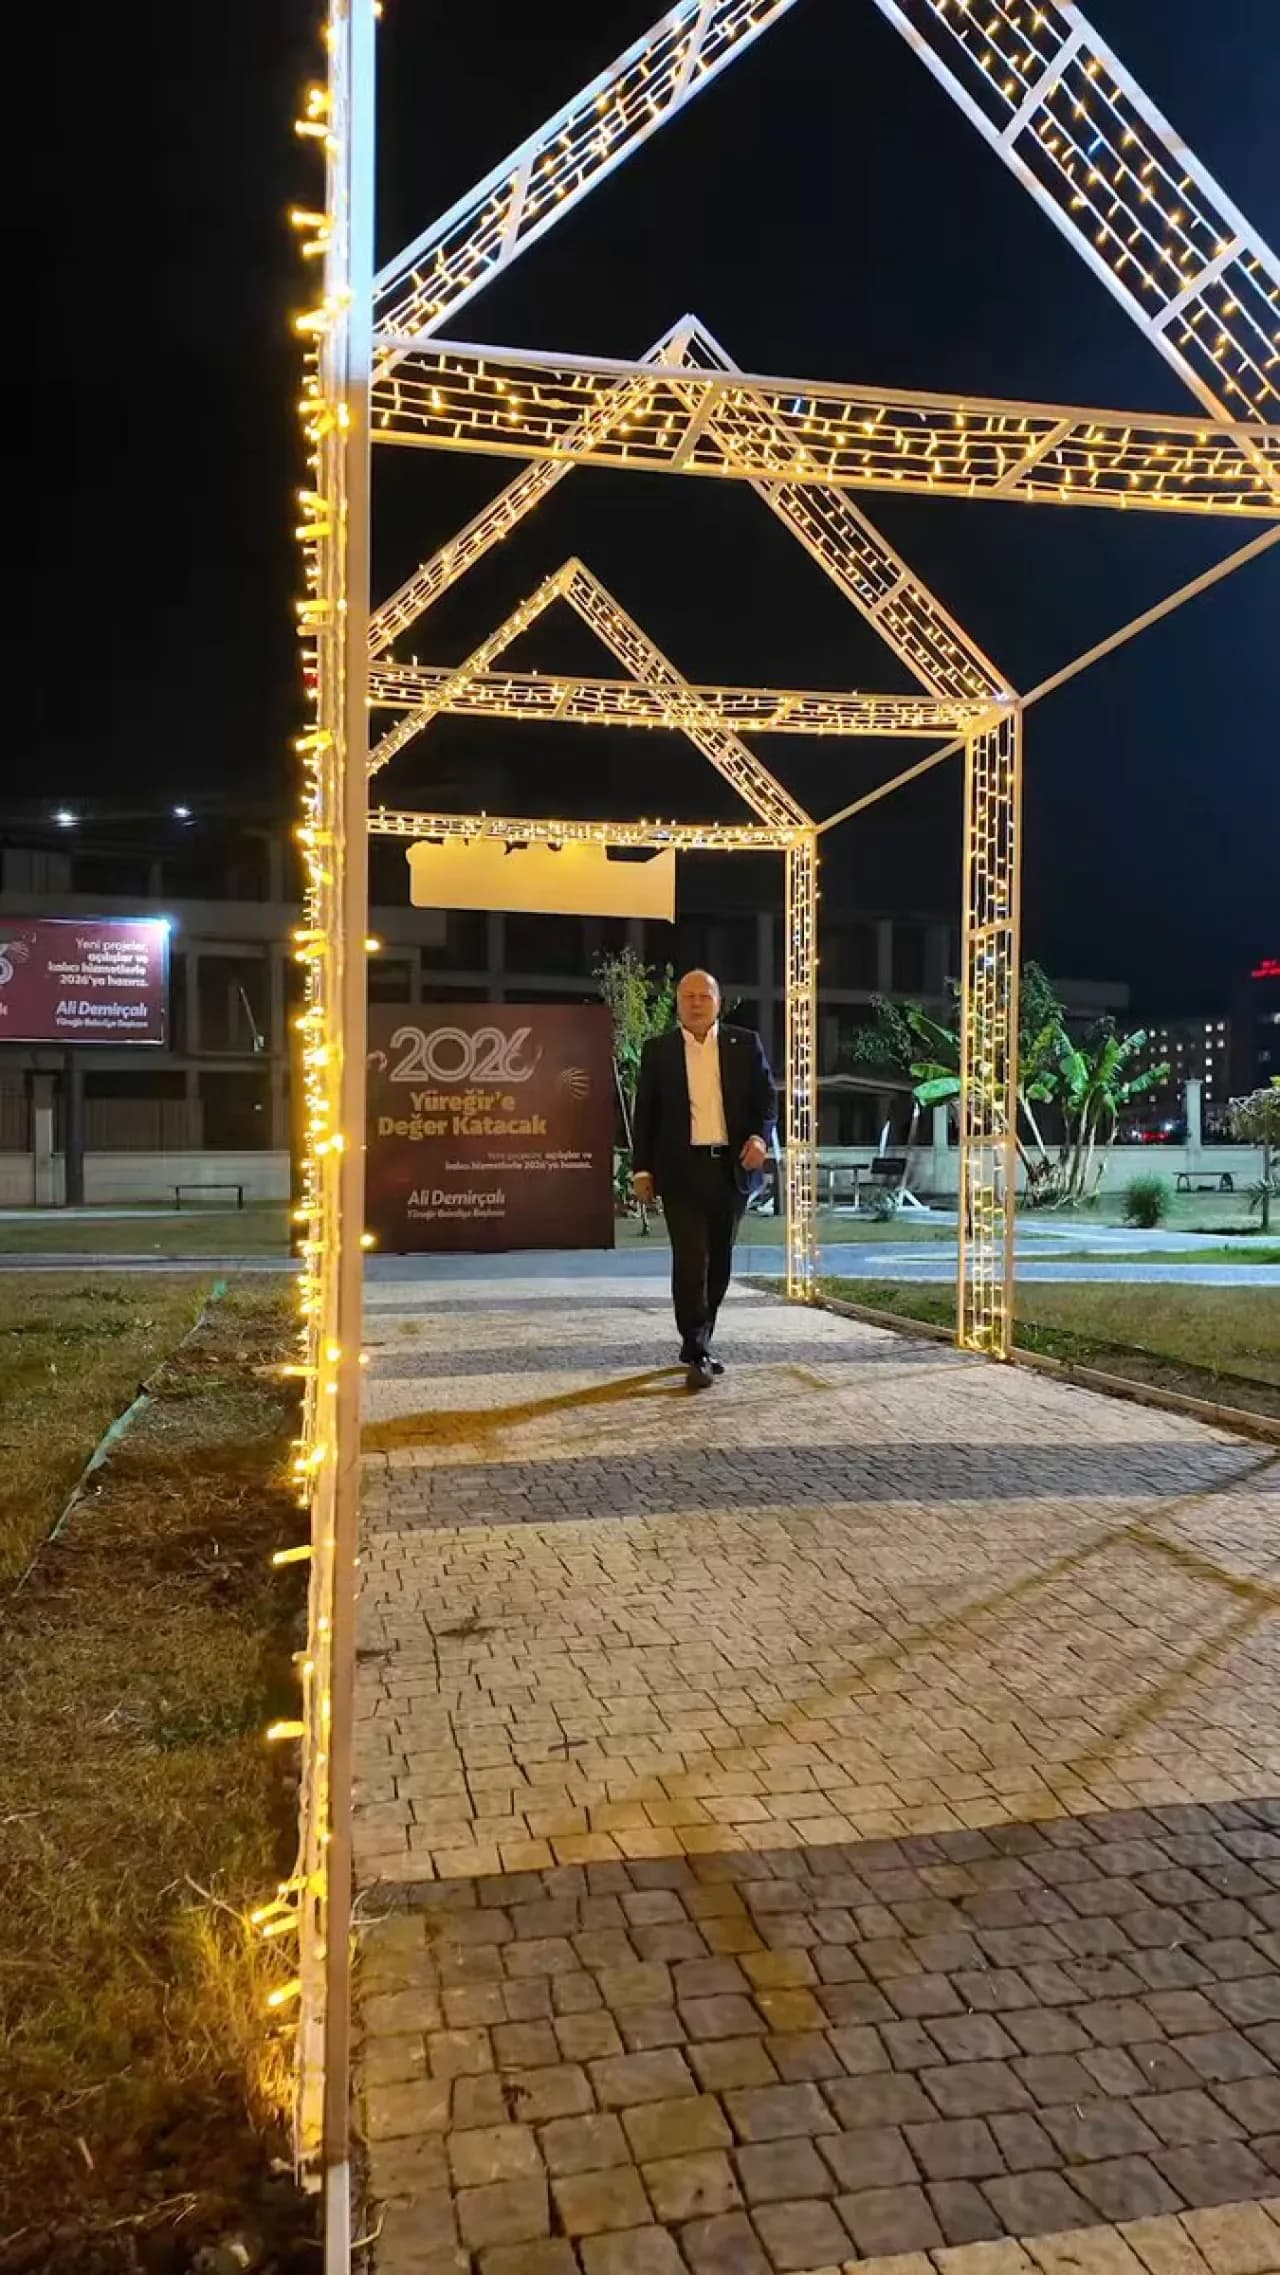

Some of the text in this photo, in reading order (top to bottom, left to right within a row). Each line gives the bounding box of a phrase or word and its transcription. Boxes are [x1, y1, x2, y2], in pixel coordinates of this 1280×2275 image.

[57, 1001, 77, 1015] Ali
[389, 1026, 542, 1082] 2026
[410, 1088, 516, 1115] Yüreğir'e
[378, 1113, 547, 1140] Değer Katacak
[408, 1188, 504, 1208] Ali Demirçalı
